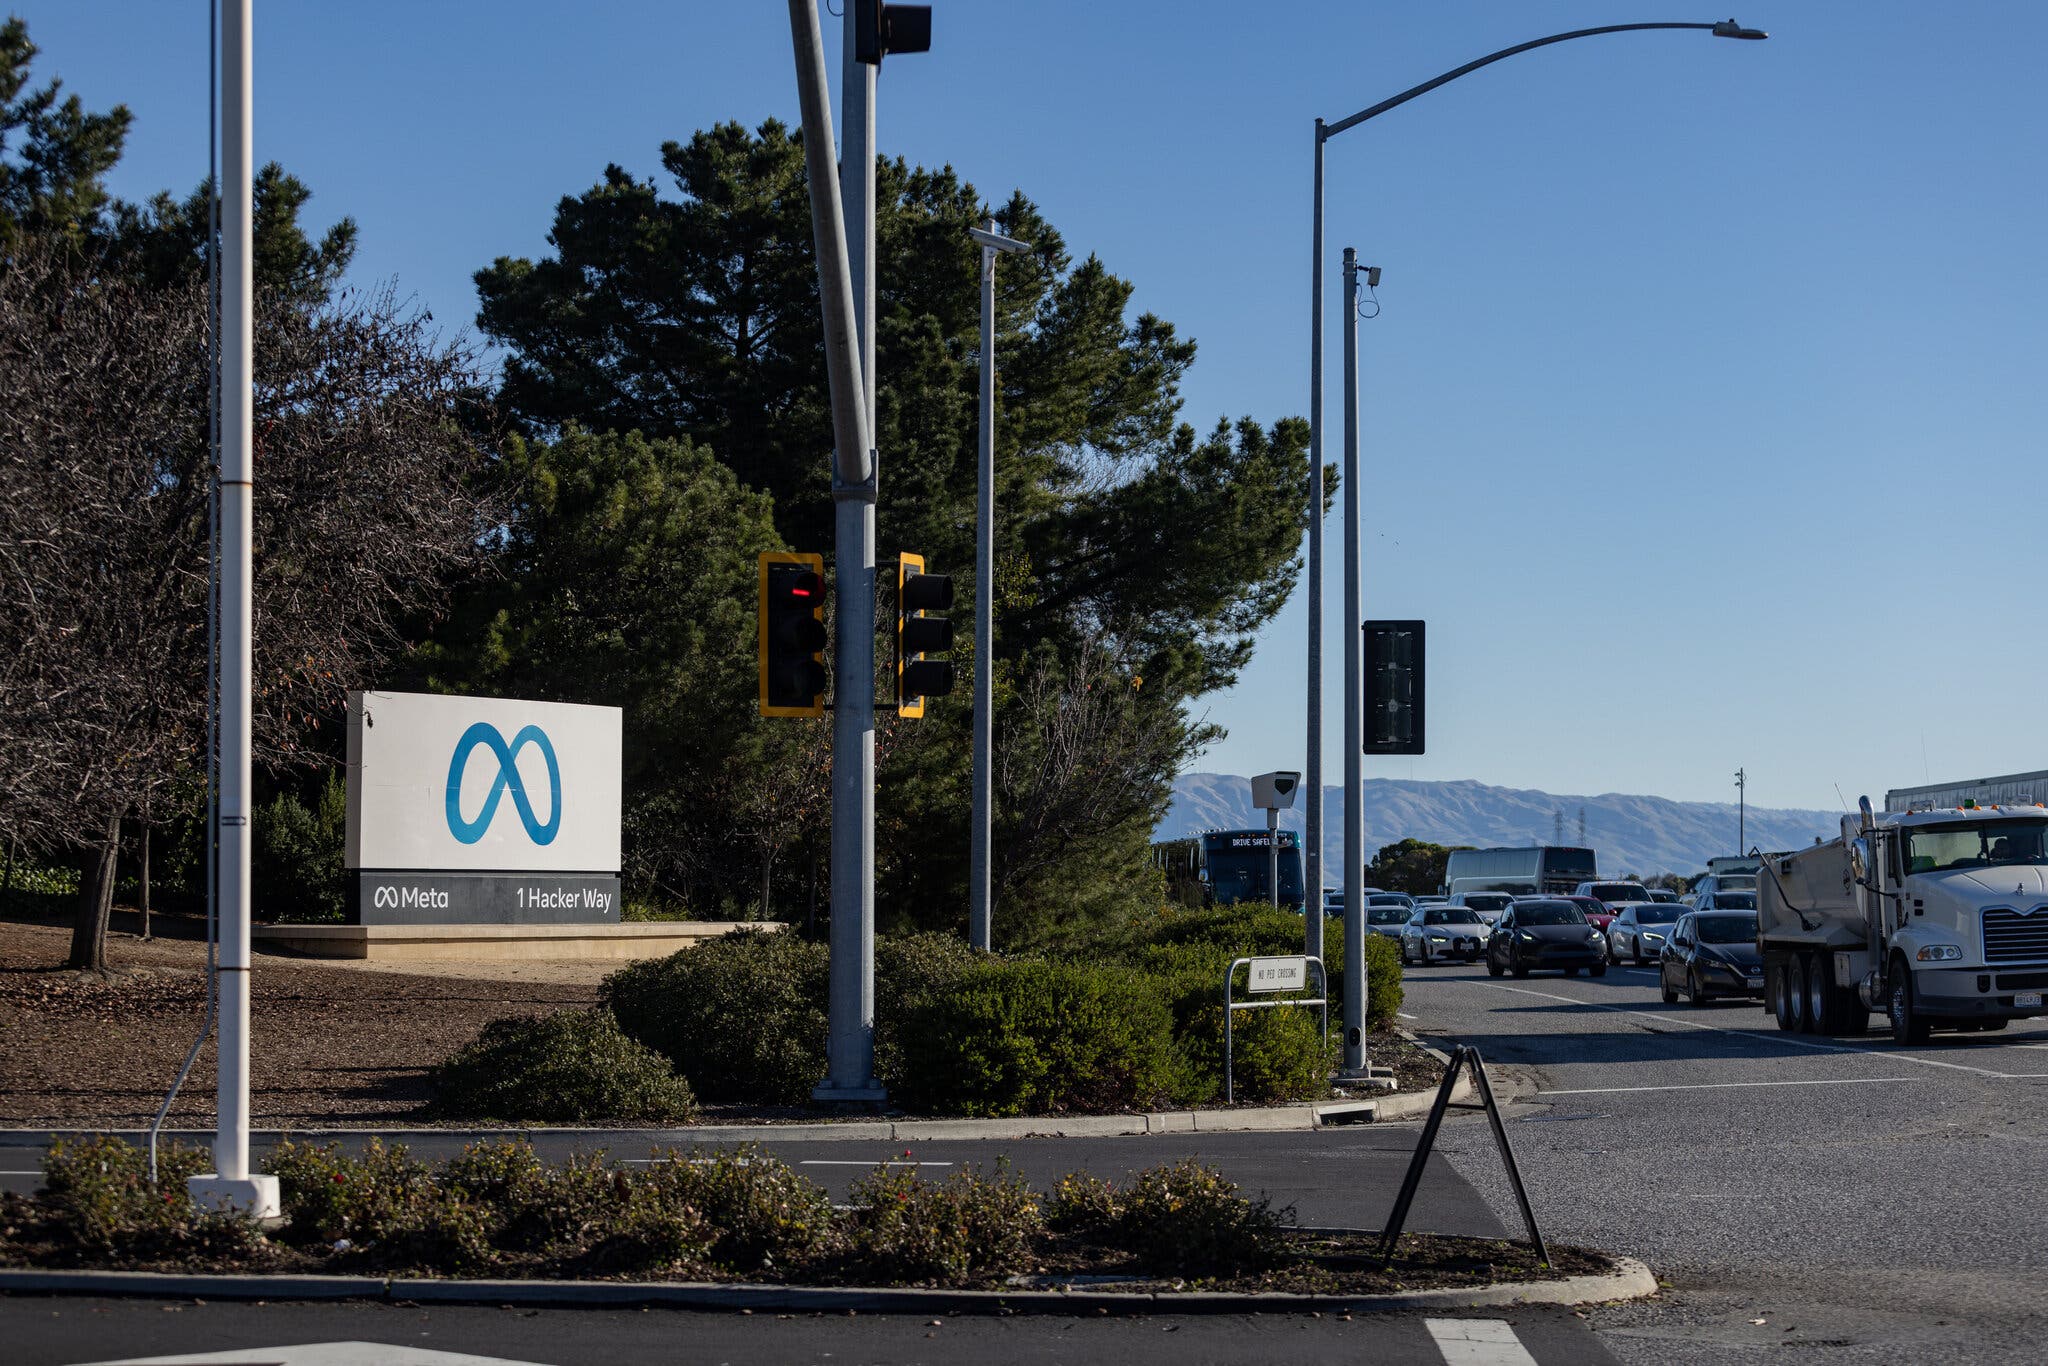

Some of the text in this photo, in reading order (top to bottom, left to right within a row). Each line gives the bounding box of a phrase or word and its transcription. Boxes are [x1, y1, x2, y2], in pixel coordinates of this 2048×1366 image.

[1232, 838, 1270, 846] DRIVE SAFEL
[401, 887, 449, 908] Meta
[517, 888, 612, 913] 1 Hacker Way
[1258, 968, 1297, 979] NO PED CROSSING
